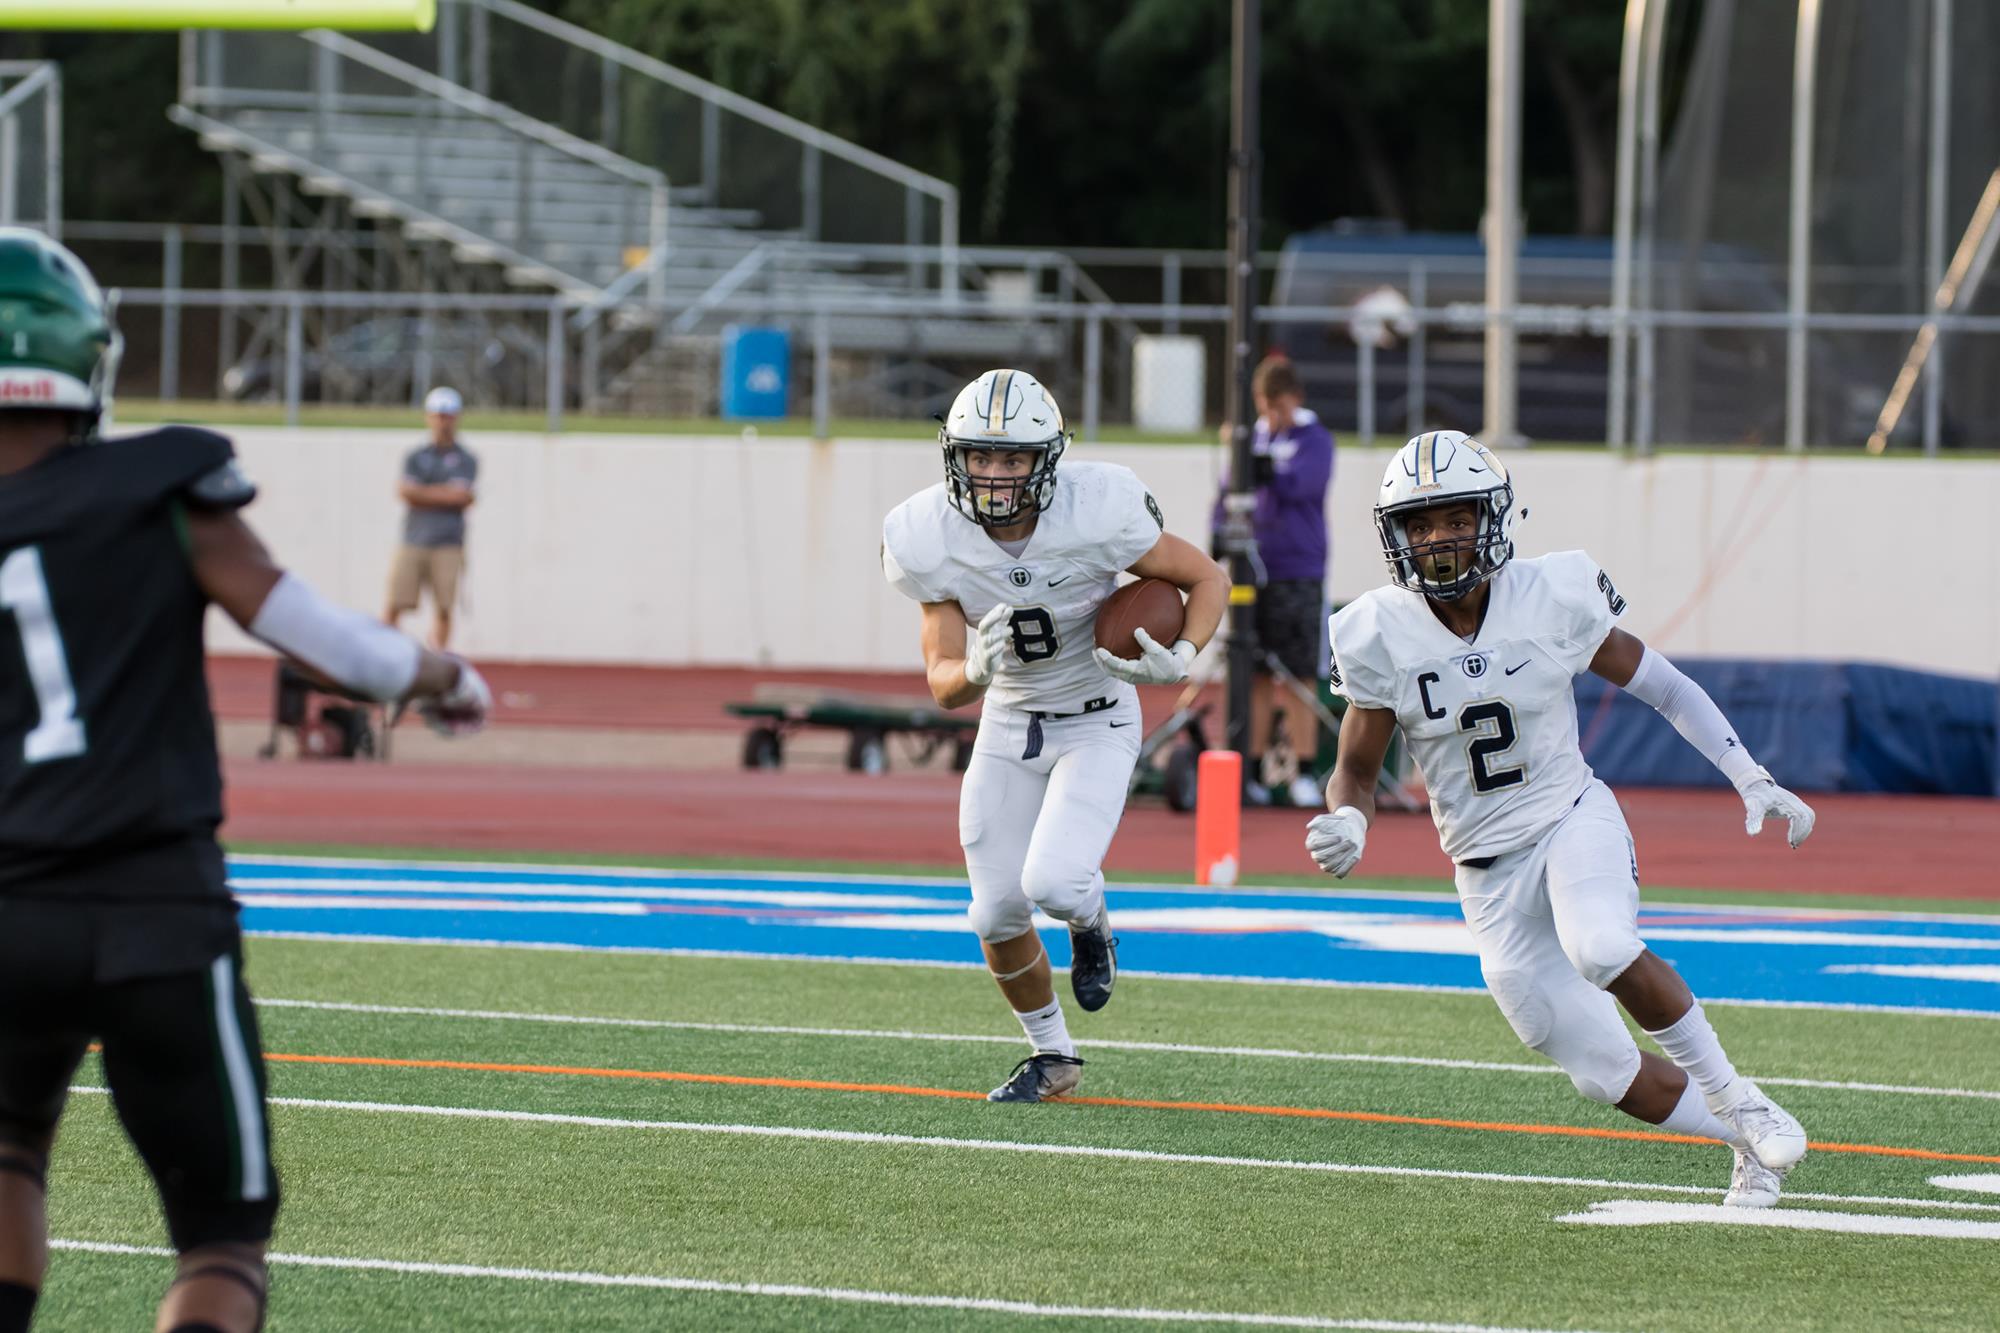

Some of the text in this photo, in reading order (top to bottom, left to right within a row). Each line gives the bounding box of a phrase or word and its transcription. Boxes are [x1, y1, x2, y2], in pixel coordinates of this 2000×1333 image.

[1597, 569, 1627, 616] 2
[0, 543, 87, 764] 1
[1006, 603, 1061, 666] 8
[1091, 700, 1100, 709] M
[1417, 671, 1447, 720] C
[1455, 696, 1529, 796] 2
